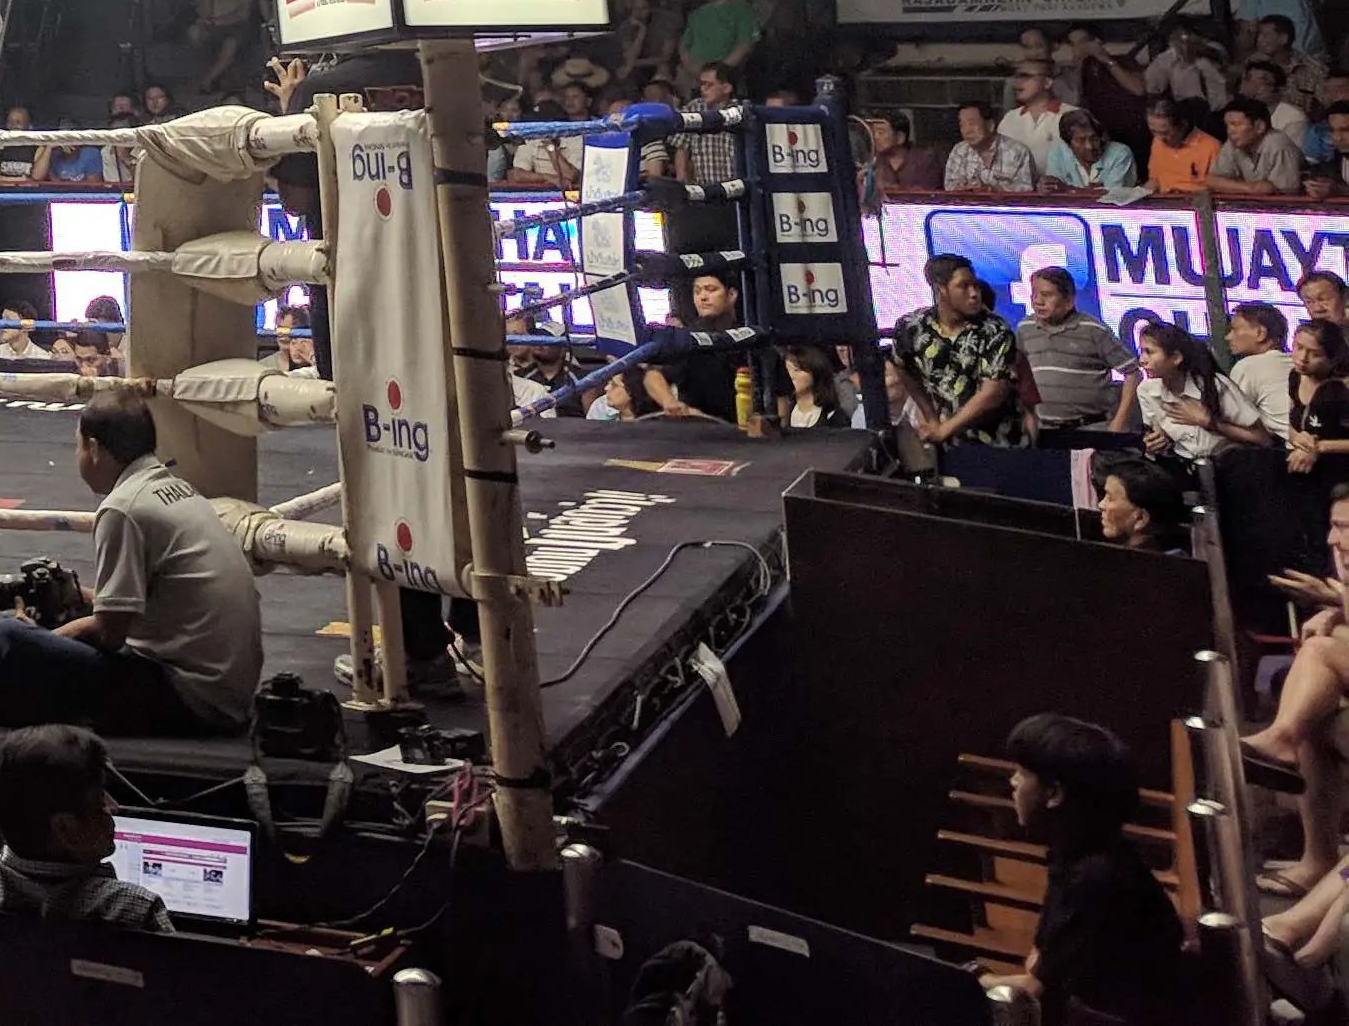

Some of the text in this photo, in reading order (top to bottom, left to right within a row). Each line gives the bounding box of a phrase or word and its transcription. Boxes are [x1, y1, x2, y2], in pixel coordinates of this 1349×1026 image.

[771, 143, 820, 169] B-ing
[786, 283, 840, 308] B-ing
[362, 403, 430, 462] B-ing
